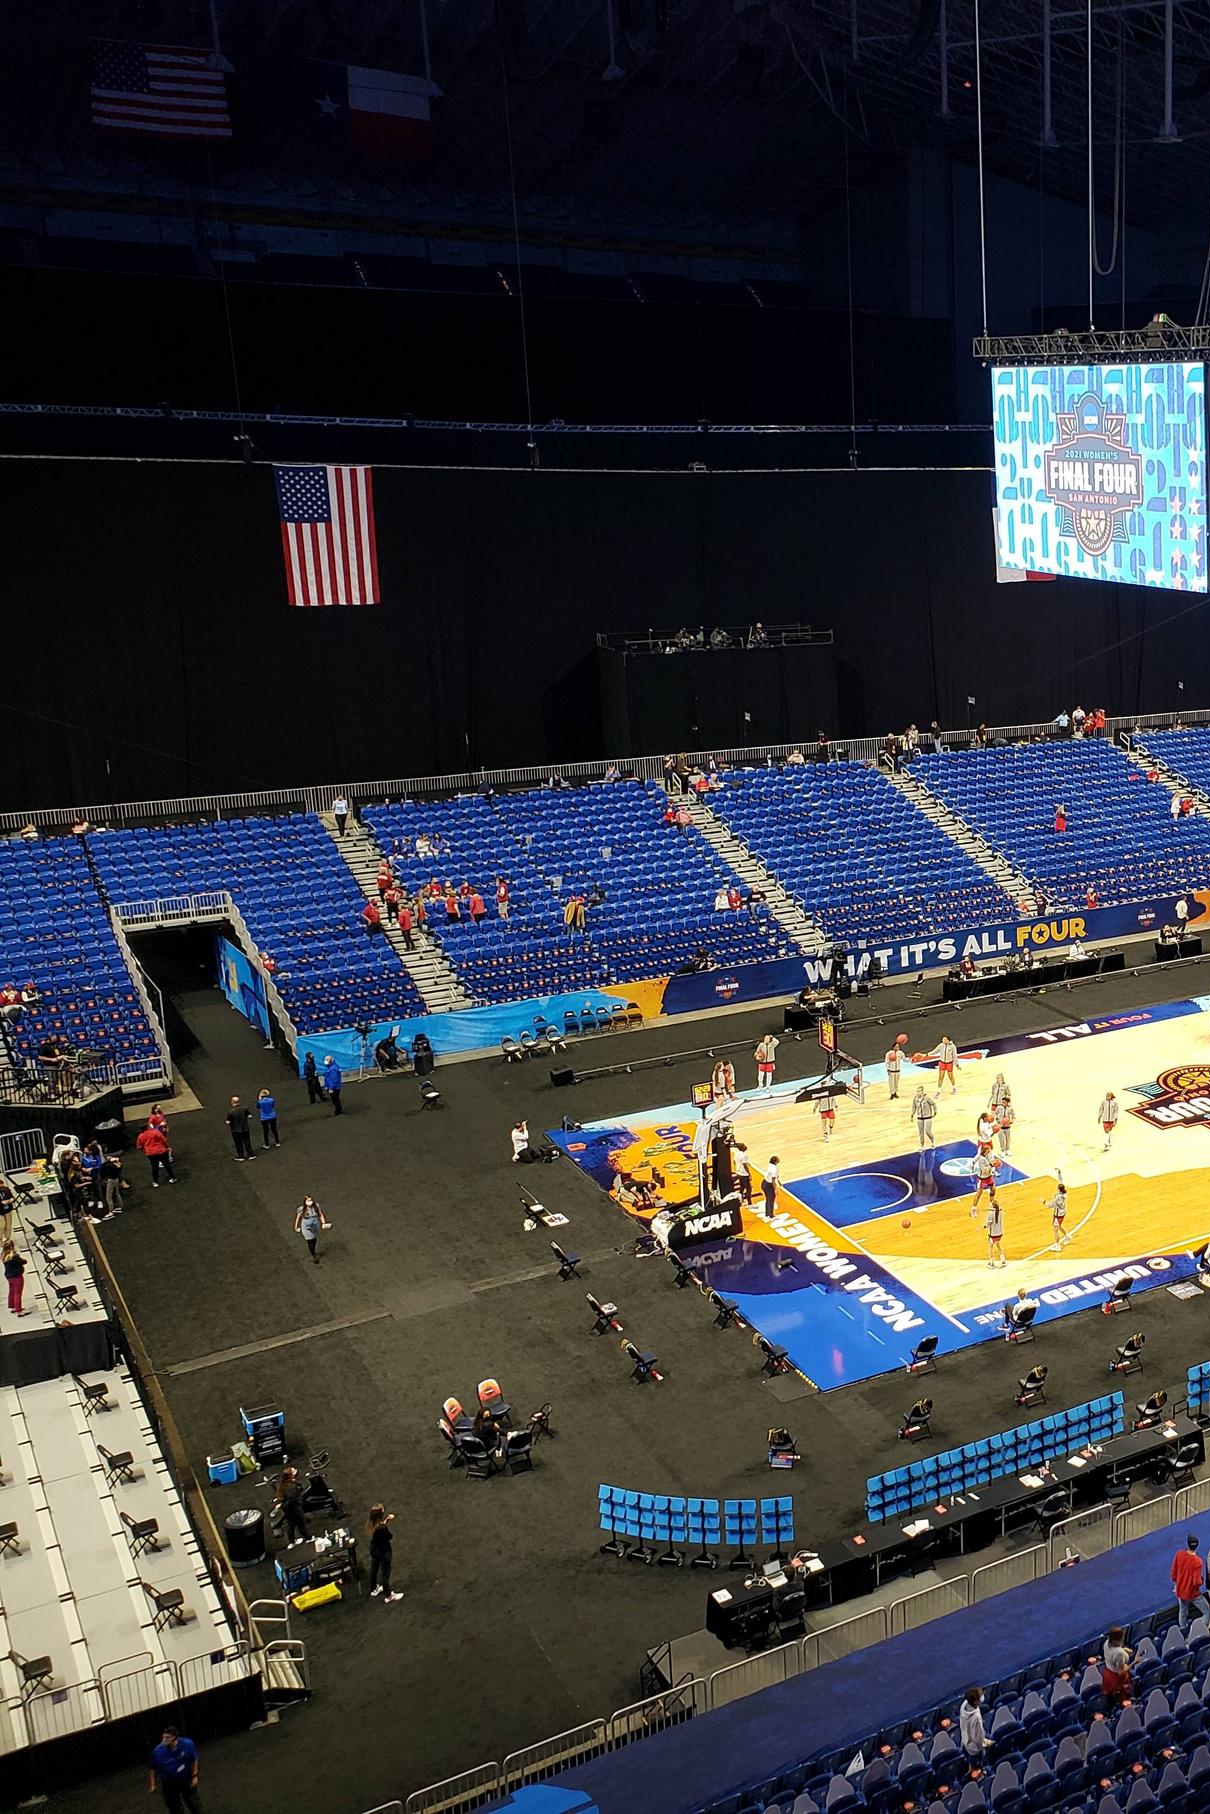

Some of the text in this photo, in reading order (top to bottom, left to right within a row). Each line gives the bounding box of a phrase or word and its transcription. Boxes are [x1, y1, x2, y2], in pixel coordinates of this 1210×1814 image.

[1065, 450, 1119, 460] 2021 WOMEN'S
[1050, 460, 1138, 495] FINAL FOUR
[1068, 493, 1118, 505] SAN ANTONIO
[901, 938, 957, 968] IT'S
[962, 930, 1012, 956] ALL
[1016, 917, 1087, 948] FOUR
[1108, 1013, 1153, 1025] FOUR
[685, 1211, 733, 1237] NCAA
[842, 1274, 926, 1332] NCAA
[974, 1307, 1007, 1325] NE
